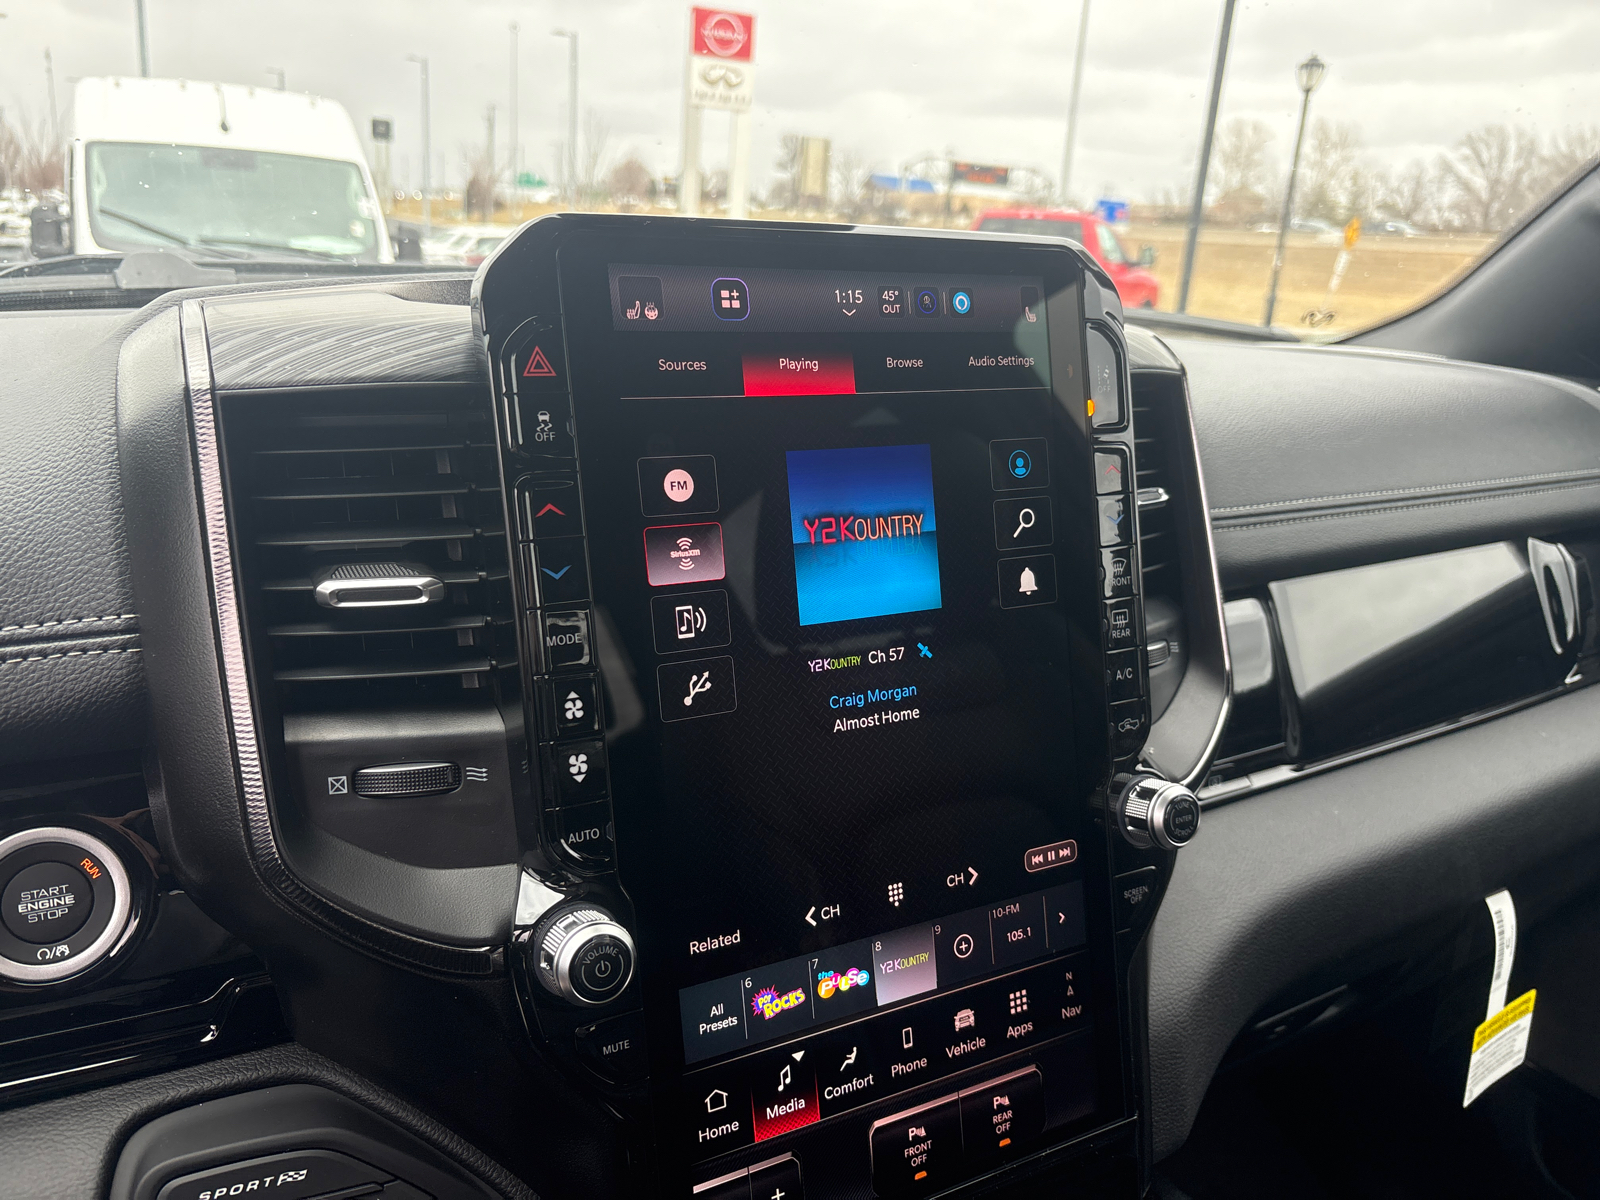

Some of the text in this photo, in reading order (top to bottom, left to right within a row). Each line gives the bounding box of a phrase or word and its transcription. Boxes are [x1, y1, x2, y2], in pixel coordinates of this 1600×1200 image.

[834, 289, 864, 305] 1:15
[882, 304, 901, 314] OUT
[658, 358, 707, 371] Sources
[779, 357, 819, 371] Playing
[886, 357, 923, 368] Browse
[968, 354, 1035, 368] Audio Settings
[535, 431, 556, 442] OFF
[670, 480, 688, 491] FM
[804, 513, 924, 545] Y2KOUNTRY
[546, 633, 583, 647] MODE
[1111, 628, 1131, 639] REAR
[807, 647, 906, 673] Y2KOUNTRY Ch 57
[1115, 667, 1133, 681] A/C
[829, 683, 918, 709] Craig Morgan
[833, 706, 920, 733] Almost Home
[1174, 801, 1191, 811] TUNE
[1175, 814, 1192, 824] ENTER
[568, 827, 600, 845] AUTO
[80, 857, 102, 879] RUN
[947, 872, 965, 888] CH
[20, 884, 69, 901] START
[1123, 885, 1149, 899] SCREEN
[1130, 895, 1143, 905] OFF
[17, 894, 76, 913] ENGINE
[992, 903, 1020, 919] 10-FM
[27, 907, 69, 924] STOP
[820, 904, 841, 920] CH
[934, 925, 941, 935] 9
[1006, 926, 1032, 943] 105.1
[689, 930, 741, 955] Related
[875, 941, 882, 951] 8
[582, 945, 620, 965] VOLUME
[812, 958, 819, 970] 7
[745, 977, 752, 988] 6
[817, 970, 834, 980] the
[1065, 971, 1073, 981] N
[709, 1003, 724, 1018] All
[764, 990, 805, 1018] ROCKS
[1061, 1004, 1082, 1019] Nav
[699, 1014, 738, 1036] Presets
[1006, 1021, 1034, 1039] Apps
[602, 1039, 631, 1056] MUTE
[945, 1036, 987, 1059] Vehicle
[890, 1055, 929, 1078] Phone
[823, 1073, 875, 1100] Comfort
[765, 1097, 806, 1121] Media
[992, 1109, 1014, 1126] REAR
[698, 1118, 740, 1144] Home
[995, 1120, 1011, 1135] OFF
[904, 1139, 933, 1159] FRONT
[911, 1152, 928, 1167] OFF
[199, 1176, 275, 1200] SPORT
